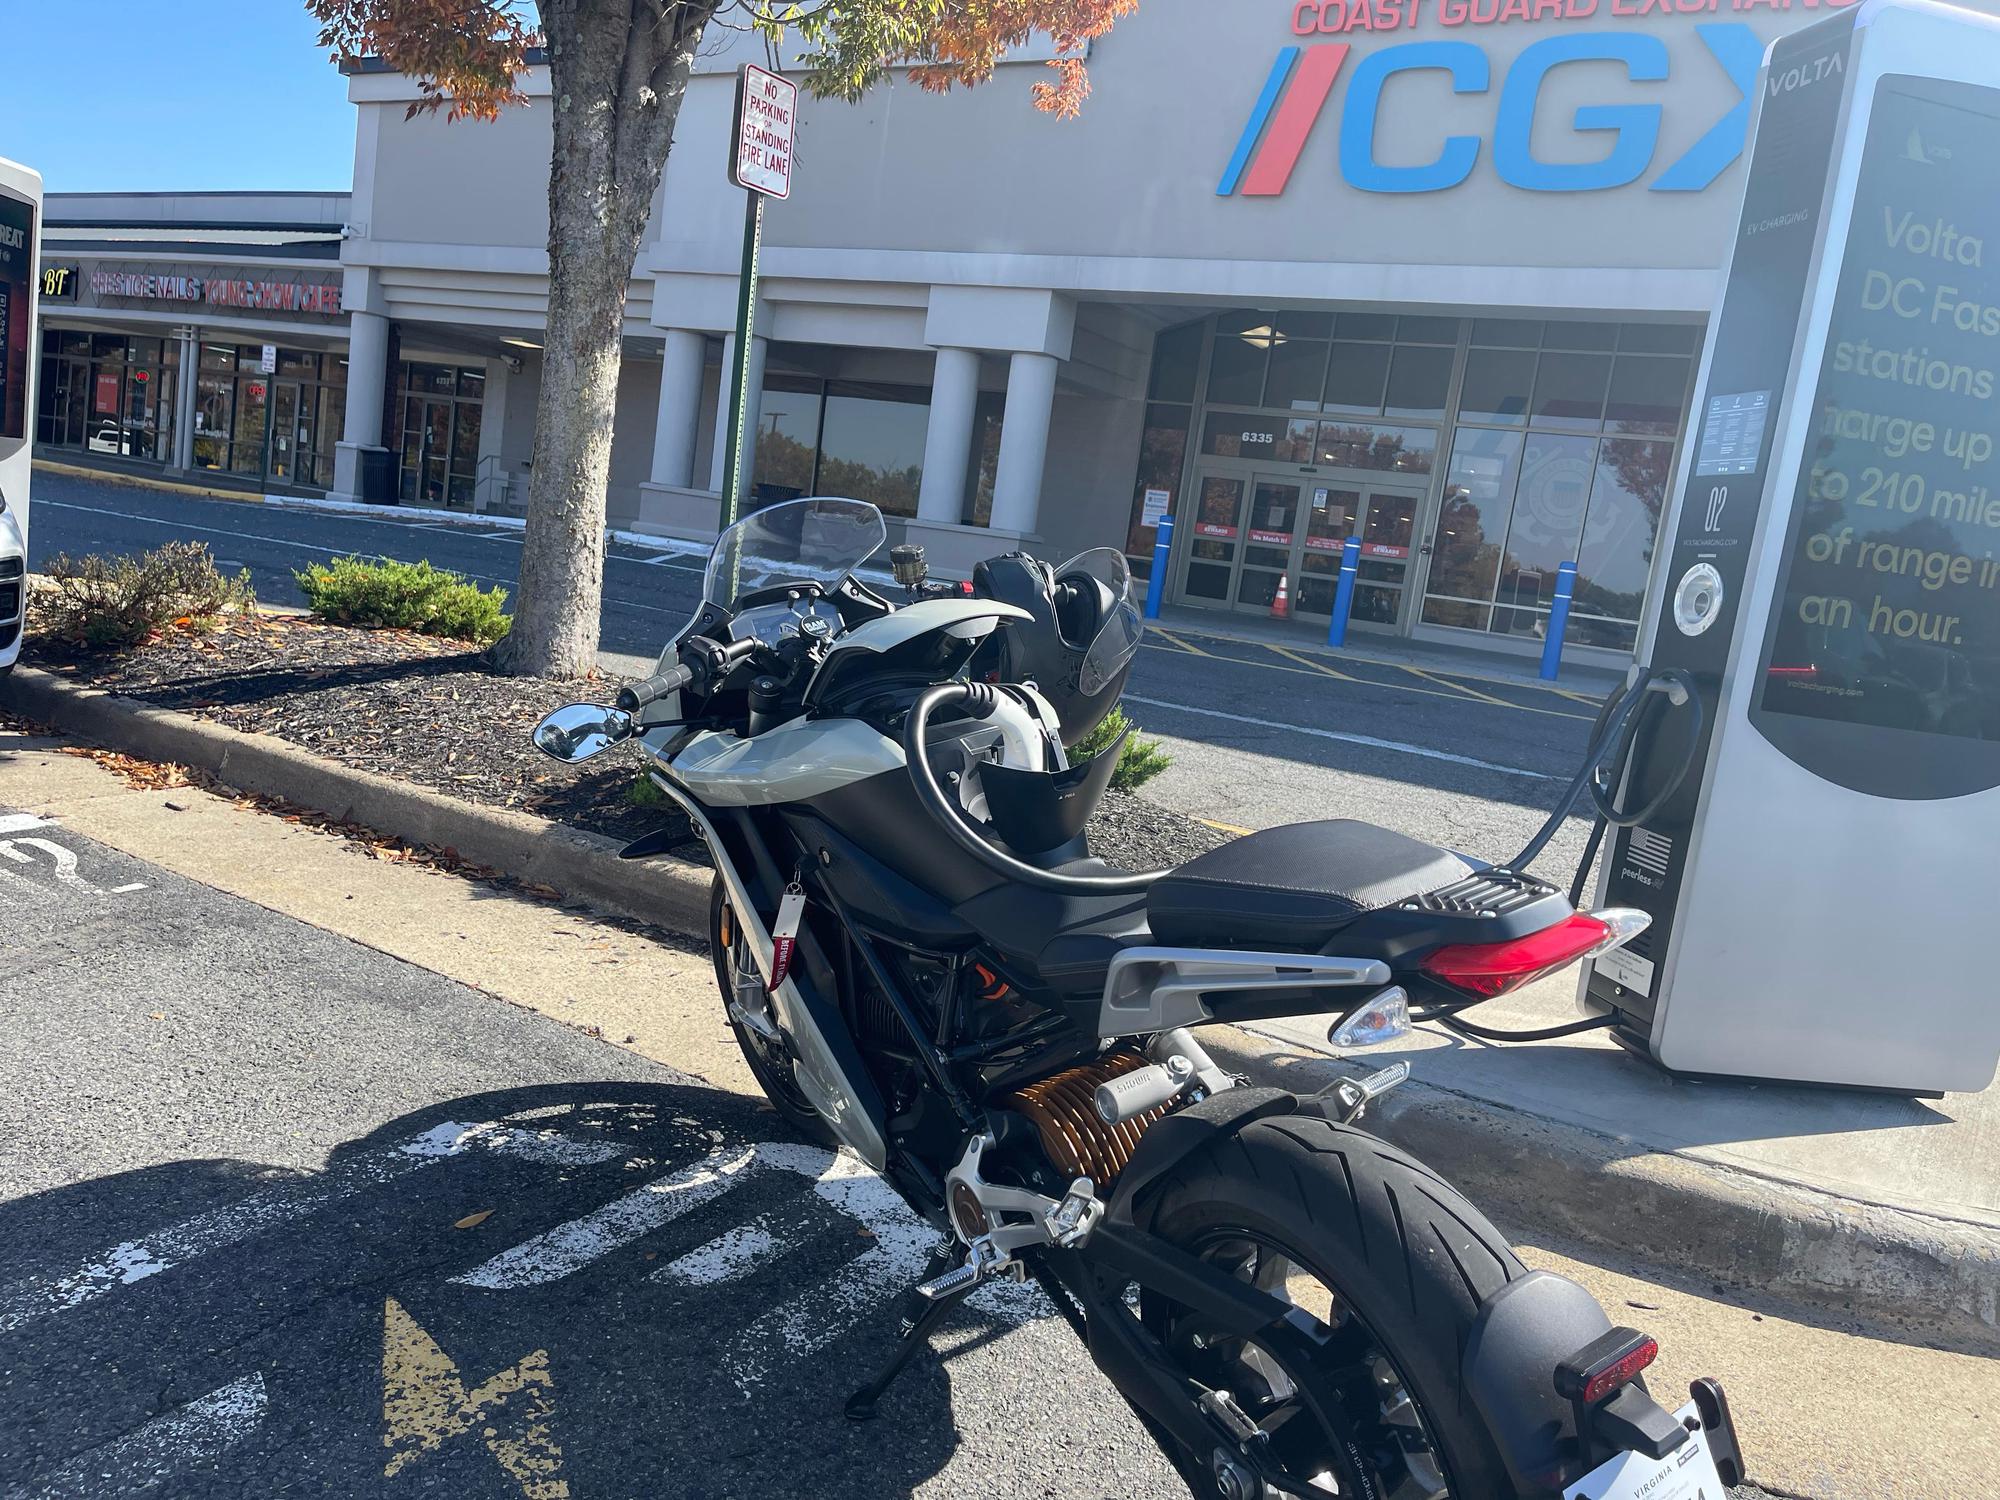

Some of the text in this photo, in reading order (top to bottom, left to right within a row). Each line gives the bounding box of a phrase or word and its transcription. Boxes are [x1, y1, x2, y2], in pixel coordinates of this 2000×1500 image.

[1291, 0, 1425, 35] COAST
[764, 81, 778, 100] NO
[1769, 52, 1843, 97] VOLTA
[750, 95, 788, 125] PARKING
[745, 123, 789, 154] STANDING
[743, 142, 788, 176] FIRE LANE
[1760, 208, 1808, 232] CHARGING
[1884, 206, 1983, 268] Volta
[91, 271, 197, 300] PRESTIGE NAILS
[253, 281, 294, 311] CHOW
[1861, 268, 1925, 319] DC
[1833, 337, 1995, 400] stations
[1241, 431, 1273, 444] 6335
[1944, 428, 1993, 471] up
[1808, 458, 1849, 501] to
[1856, 466, 1926, 513] 210
[1704, 486, 1728, 532] 02
[1806, 526, 1854, 565] of
[1856, 539, 1972, 591] range
[1799, 594, 1963, 645] an hour.
[780, 939, 790, 962] BEFORE
[1633, 1466, 1673, 1499] VIRGINIA
